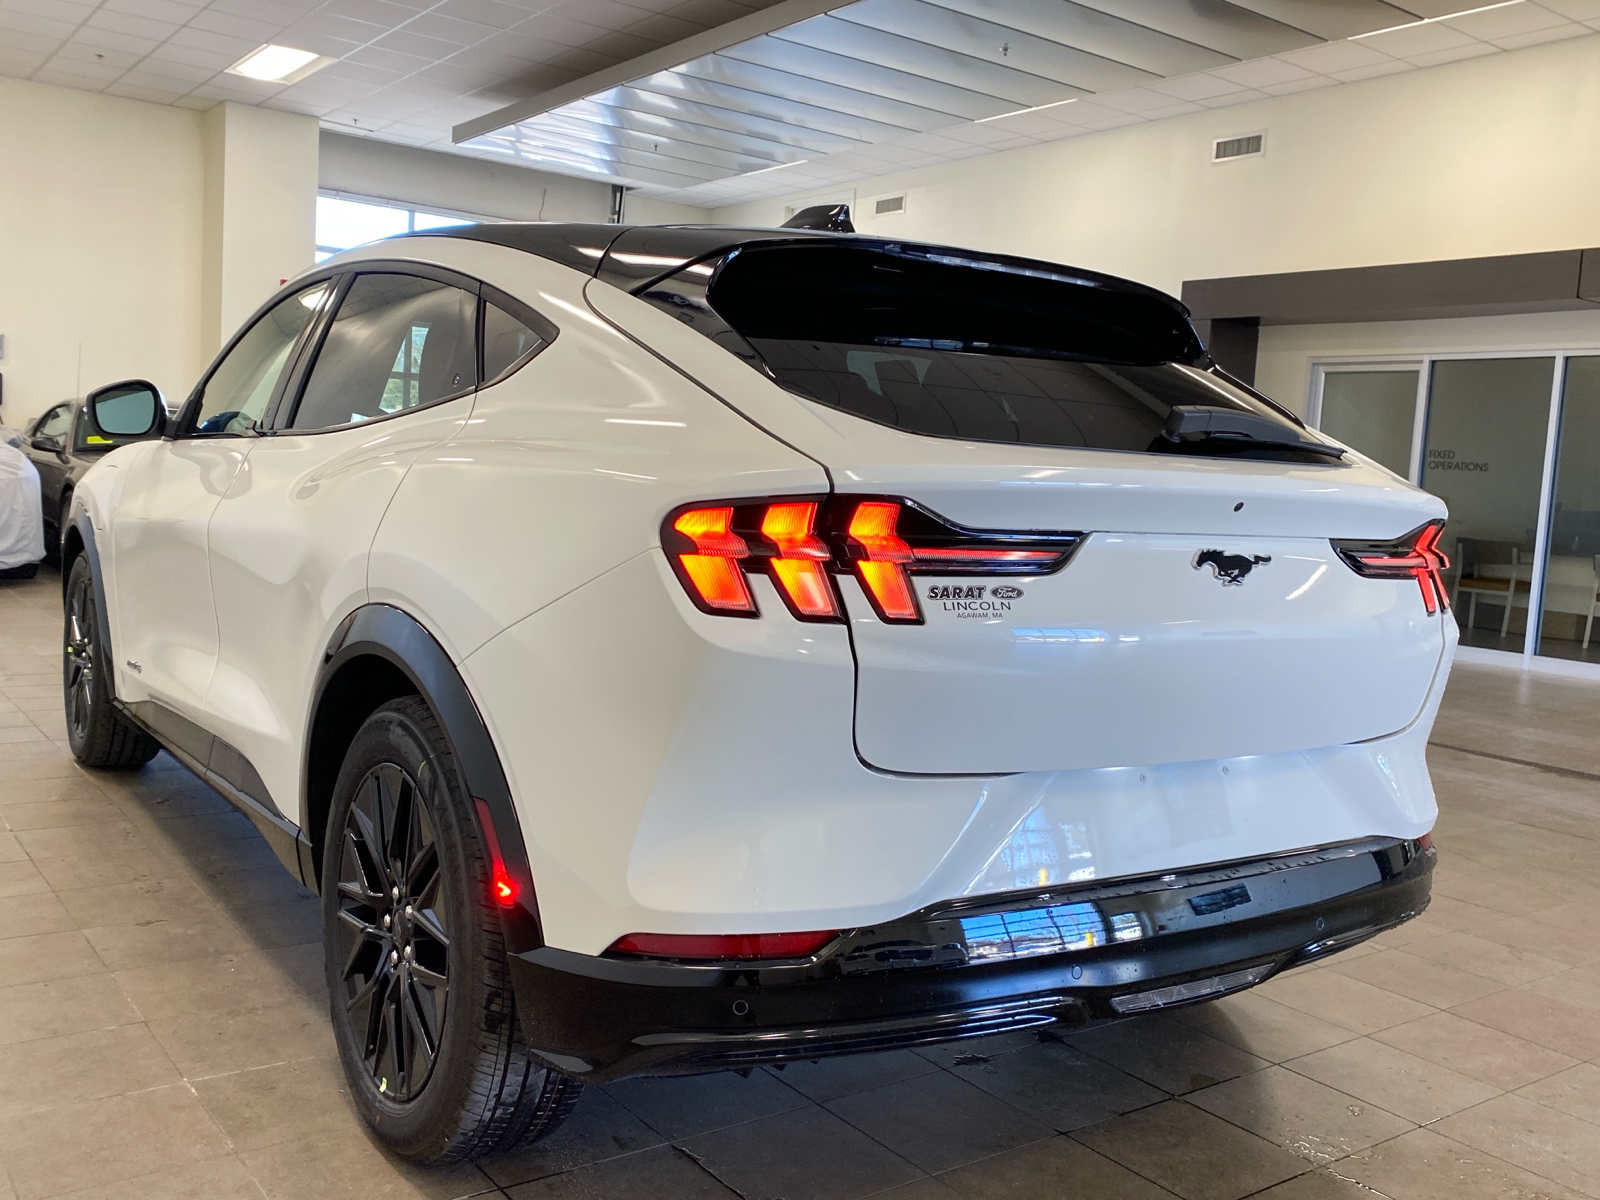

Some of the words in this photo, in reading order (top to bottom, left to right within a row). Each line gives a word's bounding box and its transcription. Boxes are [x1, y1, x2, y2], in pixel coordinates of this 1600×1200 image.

[1428, 449, 1456, 459] FIXED
[1428, 461, 1489, 472] OPERATIONS
[928, 585, 986, 600] SARAT
[993, 586, 1021, 599] Ford
[943, 601, 1011, 611] LINCOLN
